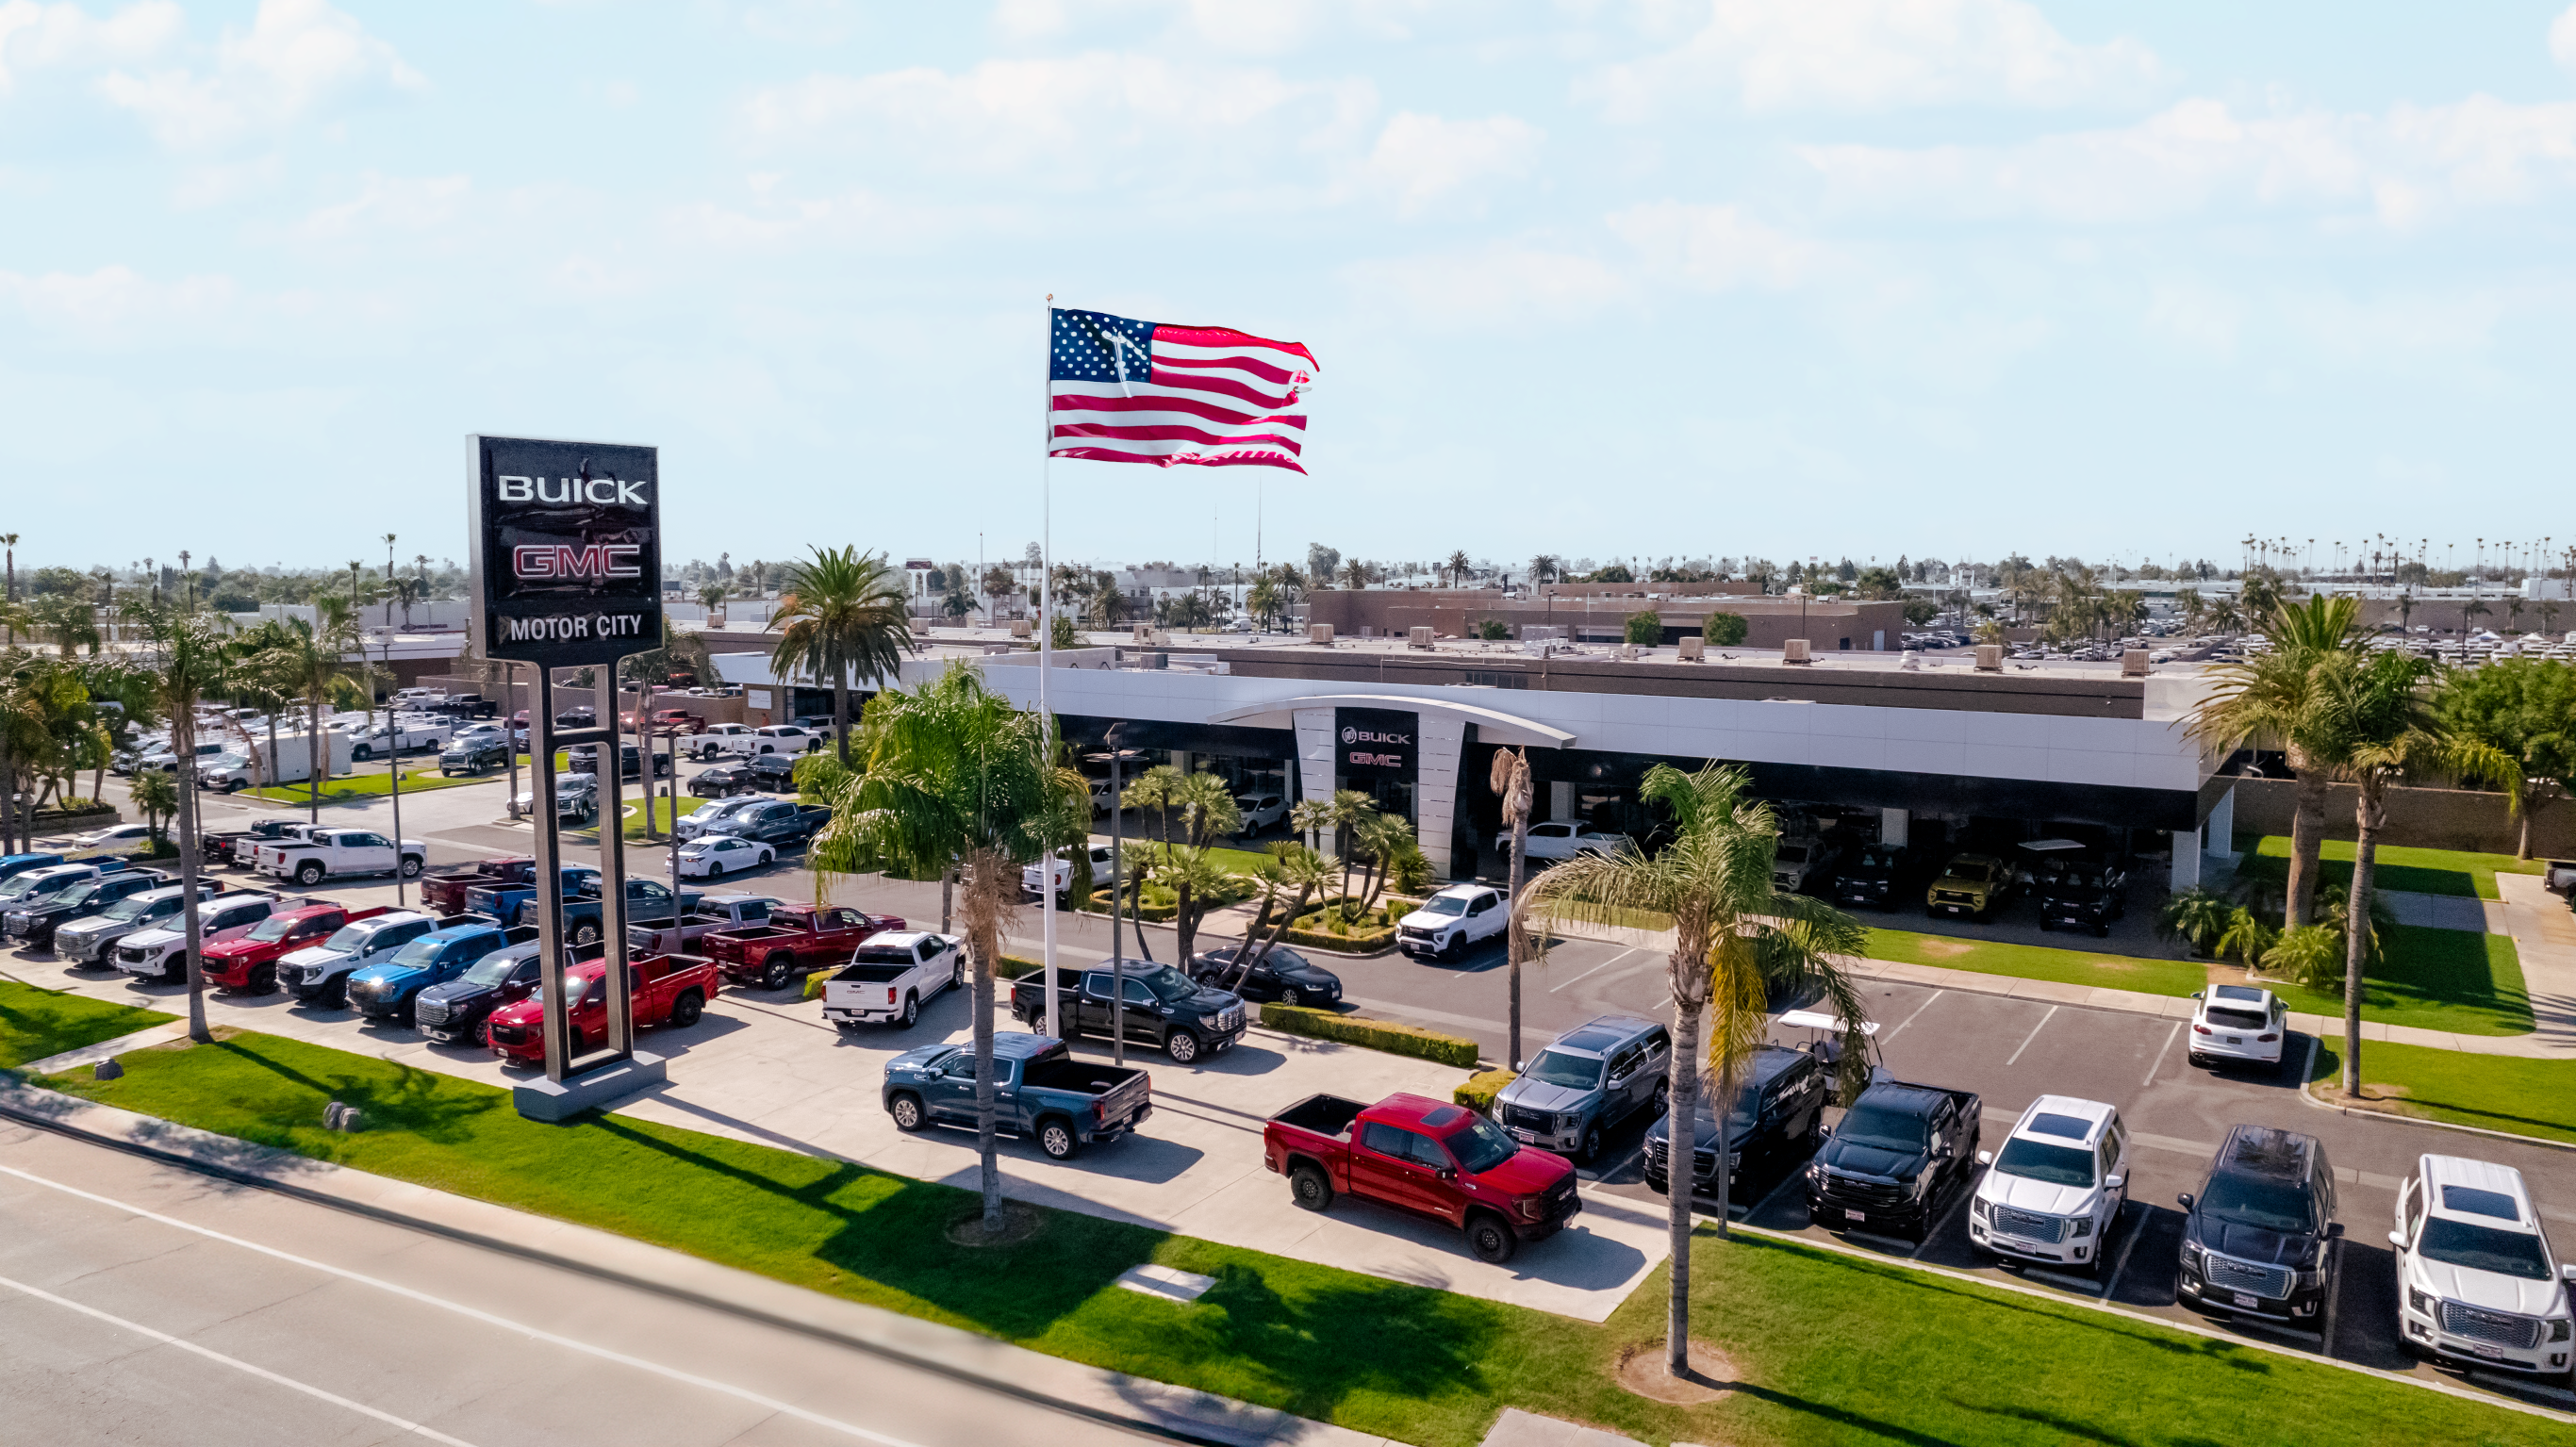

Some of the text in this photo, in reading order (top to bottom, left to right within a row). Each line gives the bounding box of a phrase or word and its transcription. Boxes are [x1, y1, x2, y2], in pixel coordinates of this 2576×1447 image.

[499, 475, 648, 504] BUICK
[513, 544, 641, 578] GMC
[511, 615, 641, 641] MOTOR CITY
[1358, 731, 1411, 745] BUICK
[1349, 752, 1402, 767] GMC
